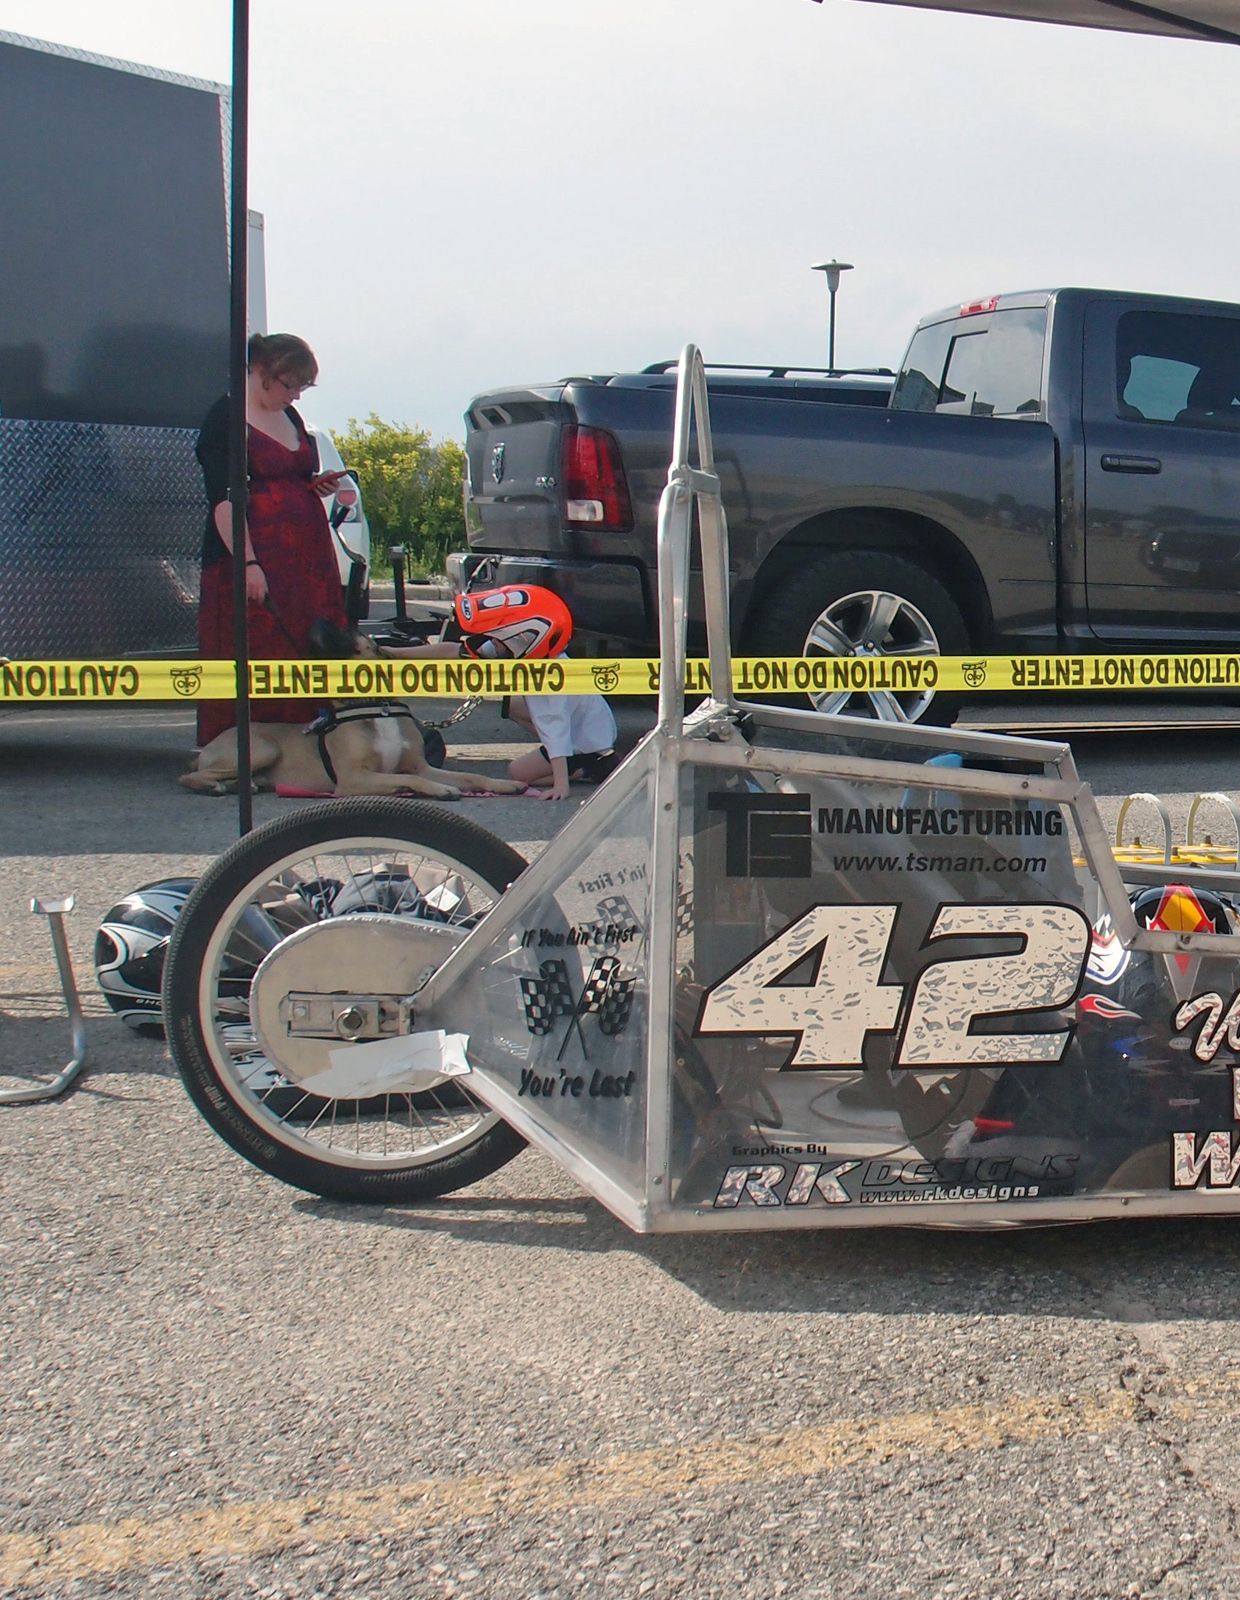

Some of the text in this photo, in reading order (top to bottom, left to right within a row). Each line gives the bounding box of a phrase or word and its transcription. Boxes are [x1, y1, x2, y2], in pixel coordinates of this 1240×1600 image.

[3, 664, 139, 697] CAUTION
[248, 662, 565, 695] CAUTION DO NOT ENTE
[737, 661, 788, 689] NOT
[794, 661, 827, 689] DO
[833, 660, 939, 689] CAUTION
[1010, 659, 1084, 686] ENTER
[1091, 658, 1135, 686] NOT
[1140, 658, 1169, 685] DO
[818, 807, 1063, 836] MANUFACTURING
[833, 852, 1047, 873] www.tsman.com
[521, 924, 637, 948] If You Ain't First
[693, 901, 1093, 1071] 42
[518, 1068, 636, 1098] You're Last
[732, 1144, 828, 1157] Graphics By
[713, 1158, 863, 1208] RK
